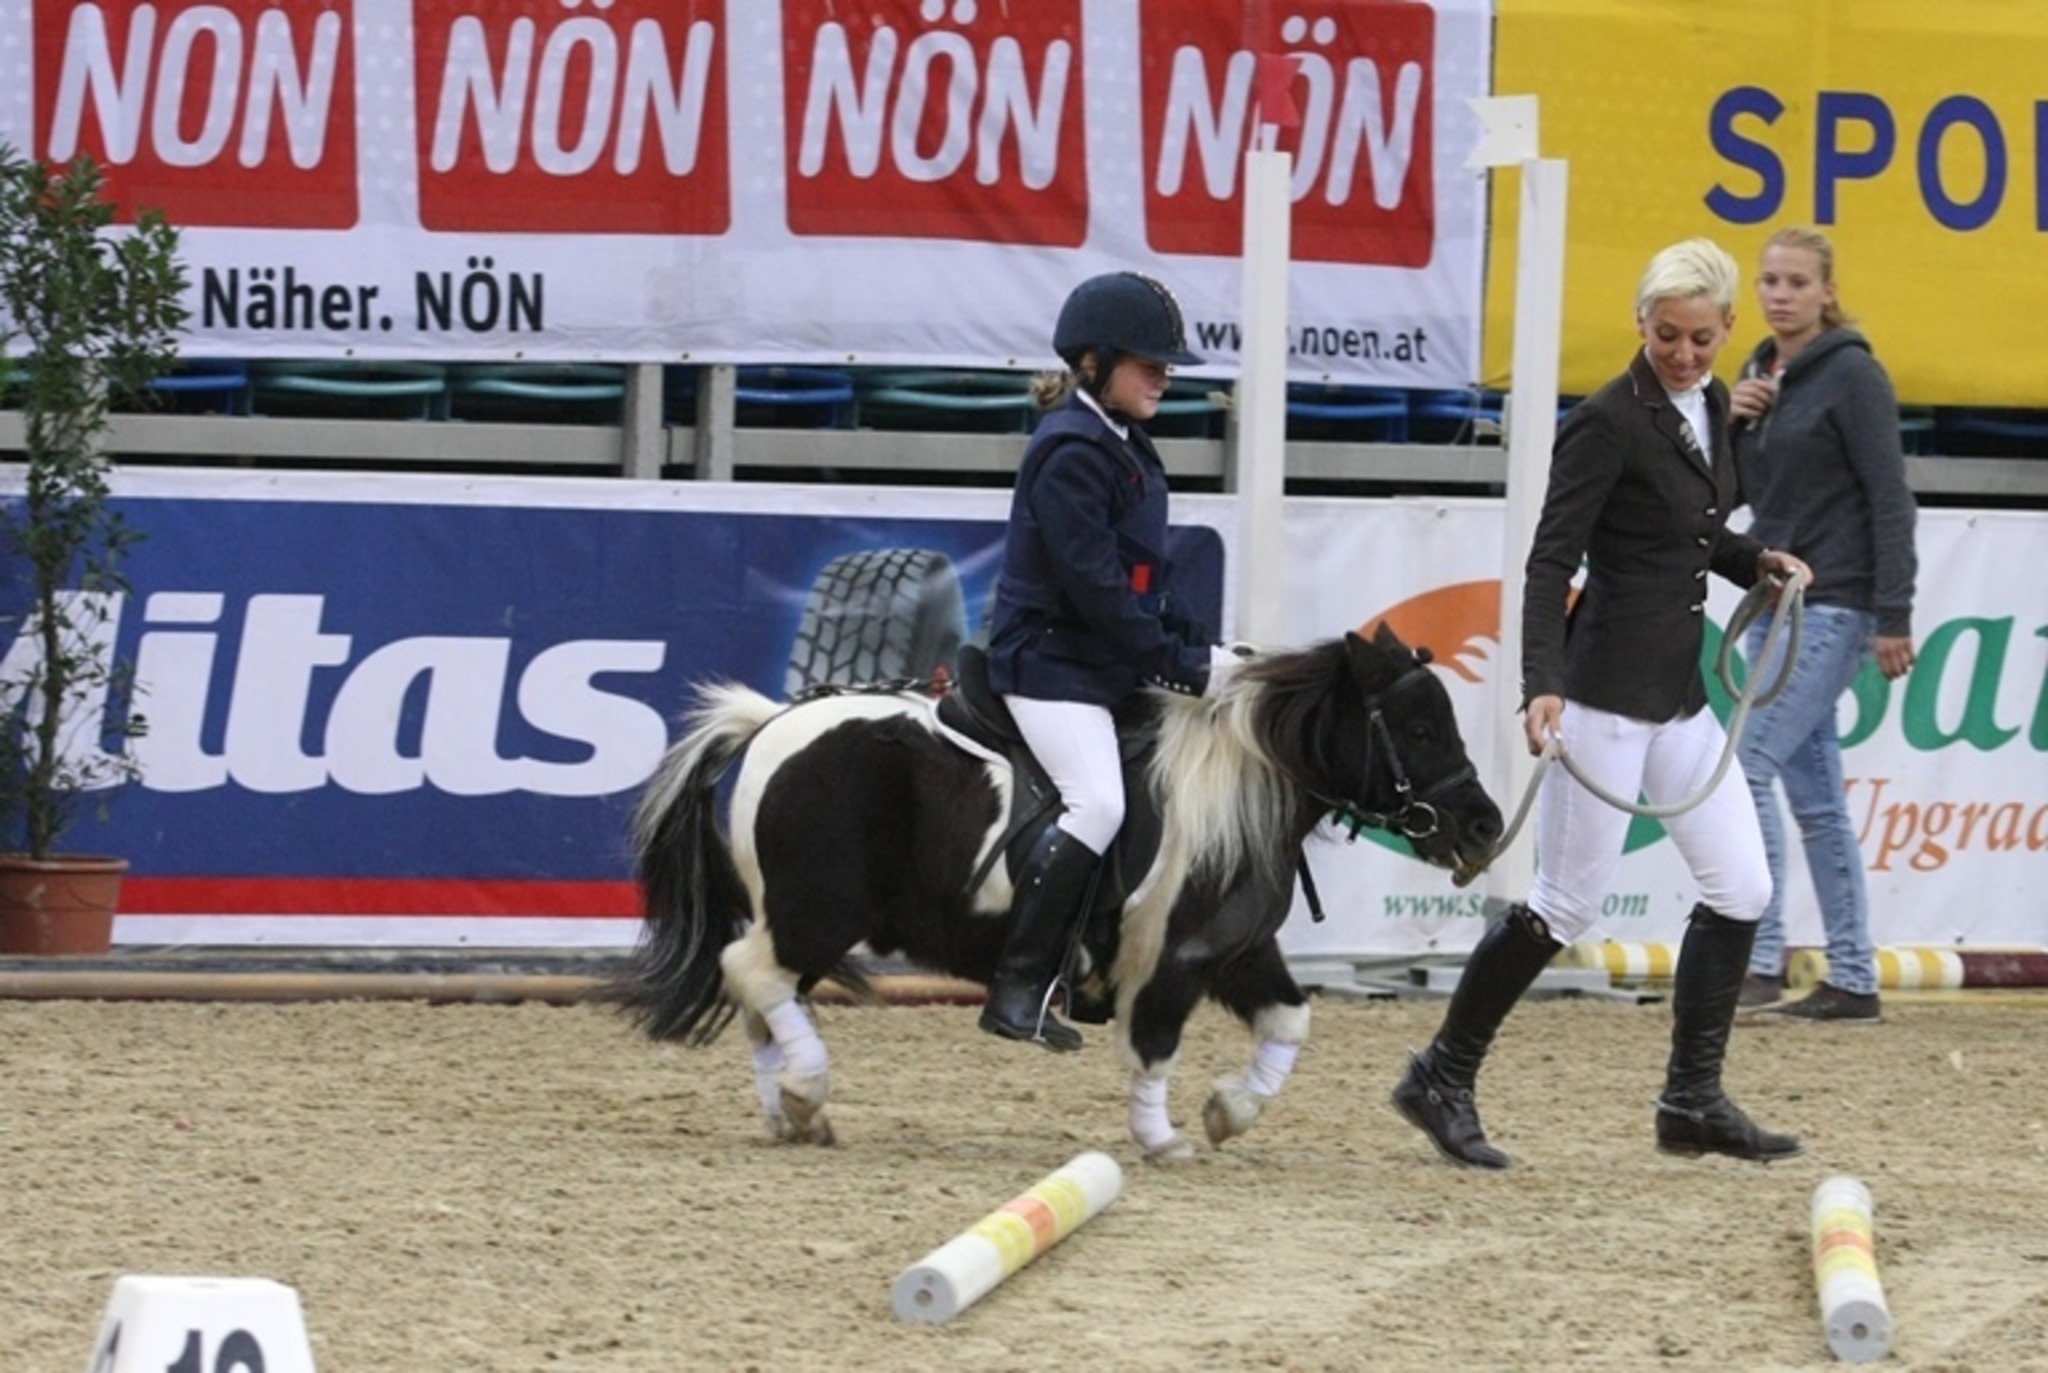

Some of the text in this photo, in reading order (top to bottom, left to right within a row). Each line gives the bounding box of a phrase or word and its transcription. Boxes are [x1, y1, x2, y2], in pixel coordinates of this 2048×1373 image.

[430, 0, 715, 177] NÖN
[798, 0, 1072, 190] NÖN
[1703, 85, 2048, 232] SPO
[202, 256, 544, 332] Näher. NÖN
[1195, 321, 1427, 363] w.noen.at
